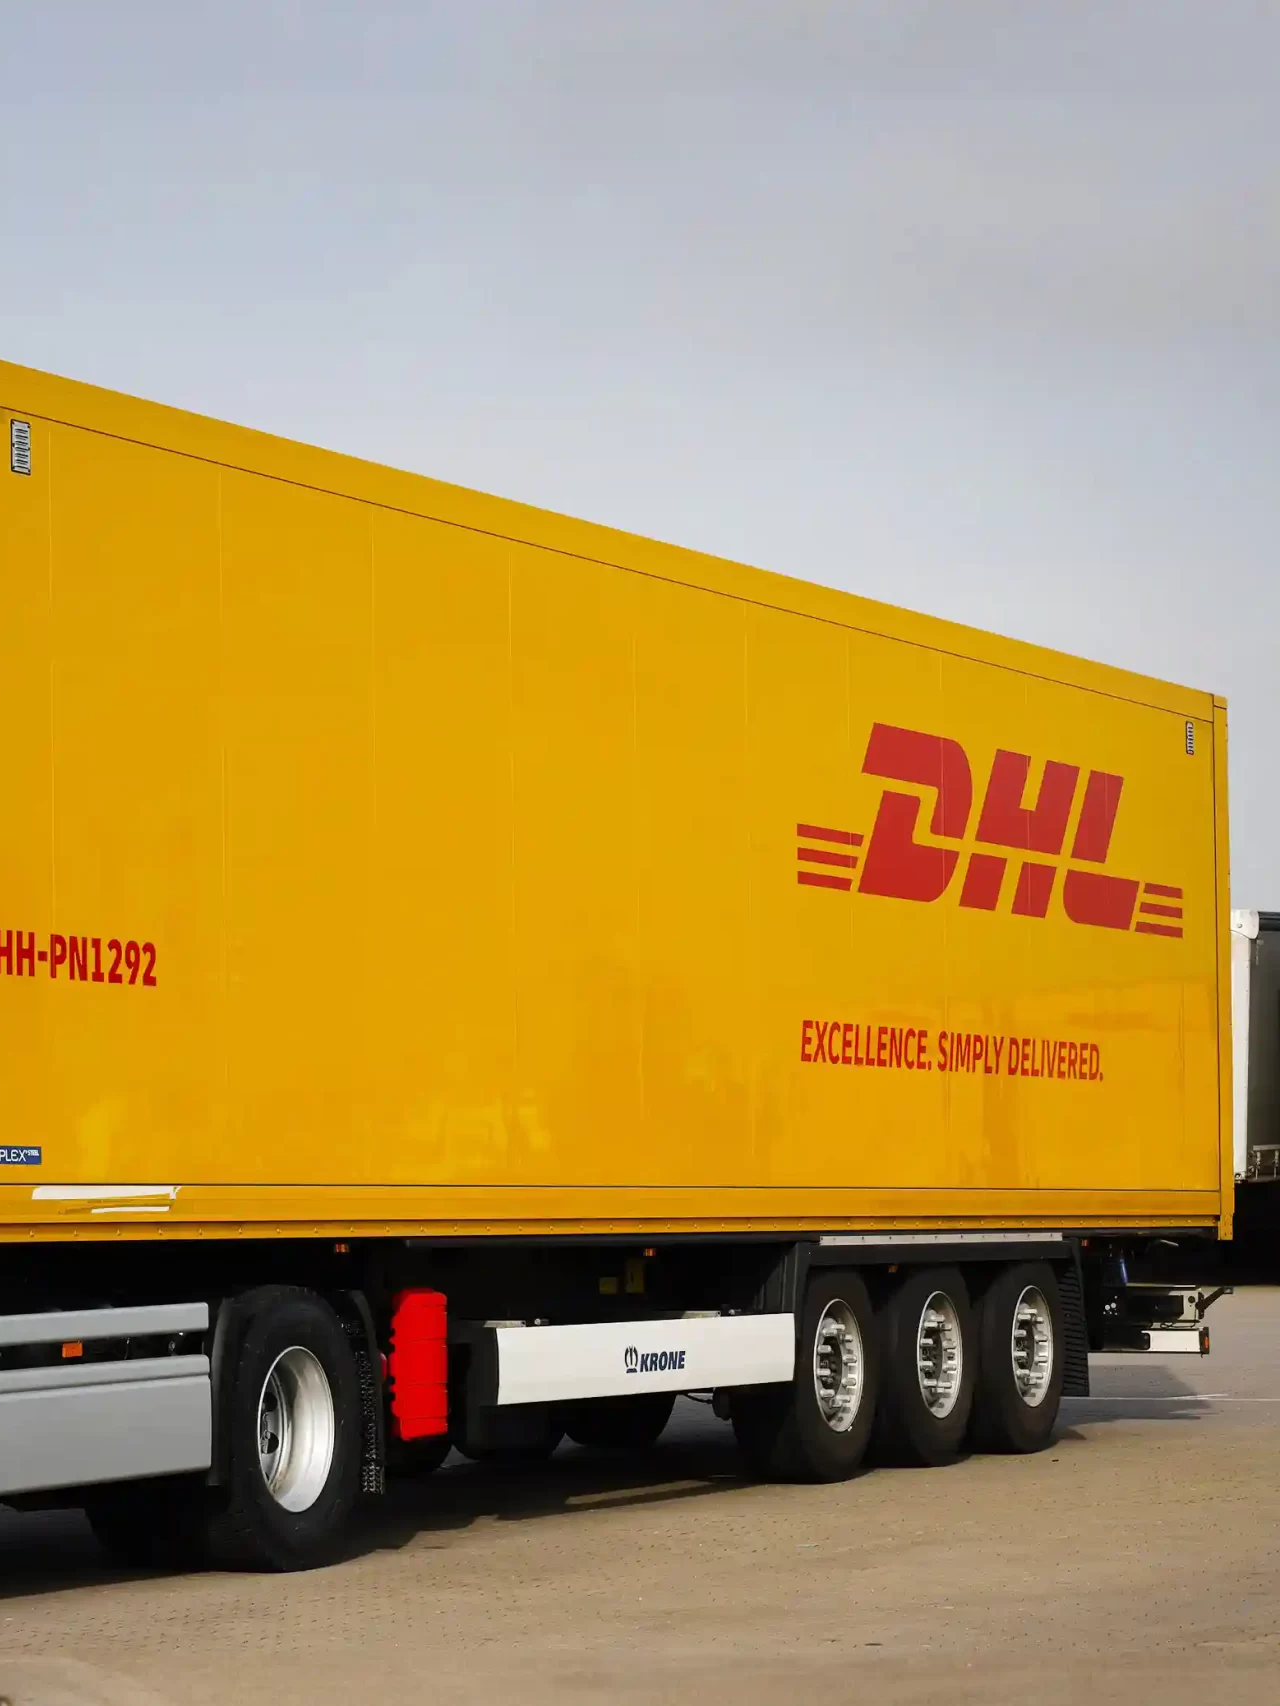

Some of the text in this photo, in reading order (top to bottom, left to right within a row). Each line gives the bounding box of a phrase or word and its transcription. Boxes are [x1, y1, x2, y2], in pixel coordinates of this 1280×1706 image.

[858, 722, 1140, 931] DHL
[800, 1019, 1105, 1082] EXCELLENCE. SIMPLY DELIVERED.
[640, 1350, 686, 1373] KRONE
